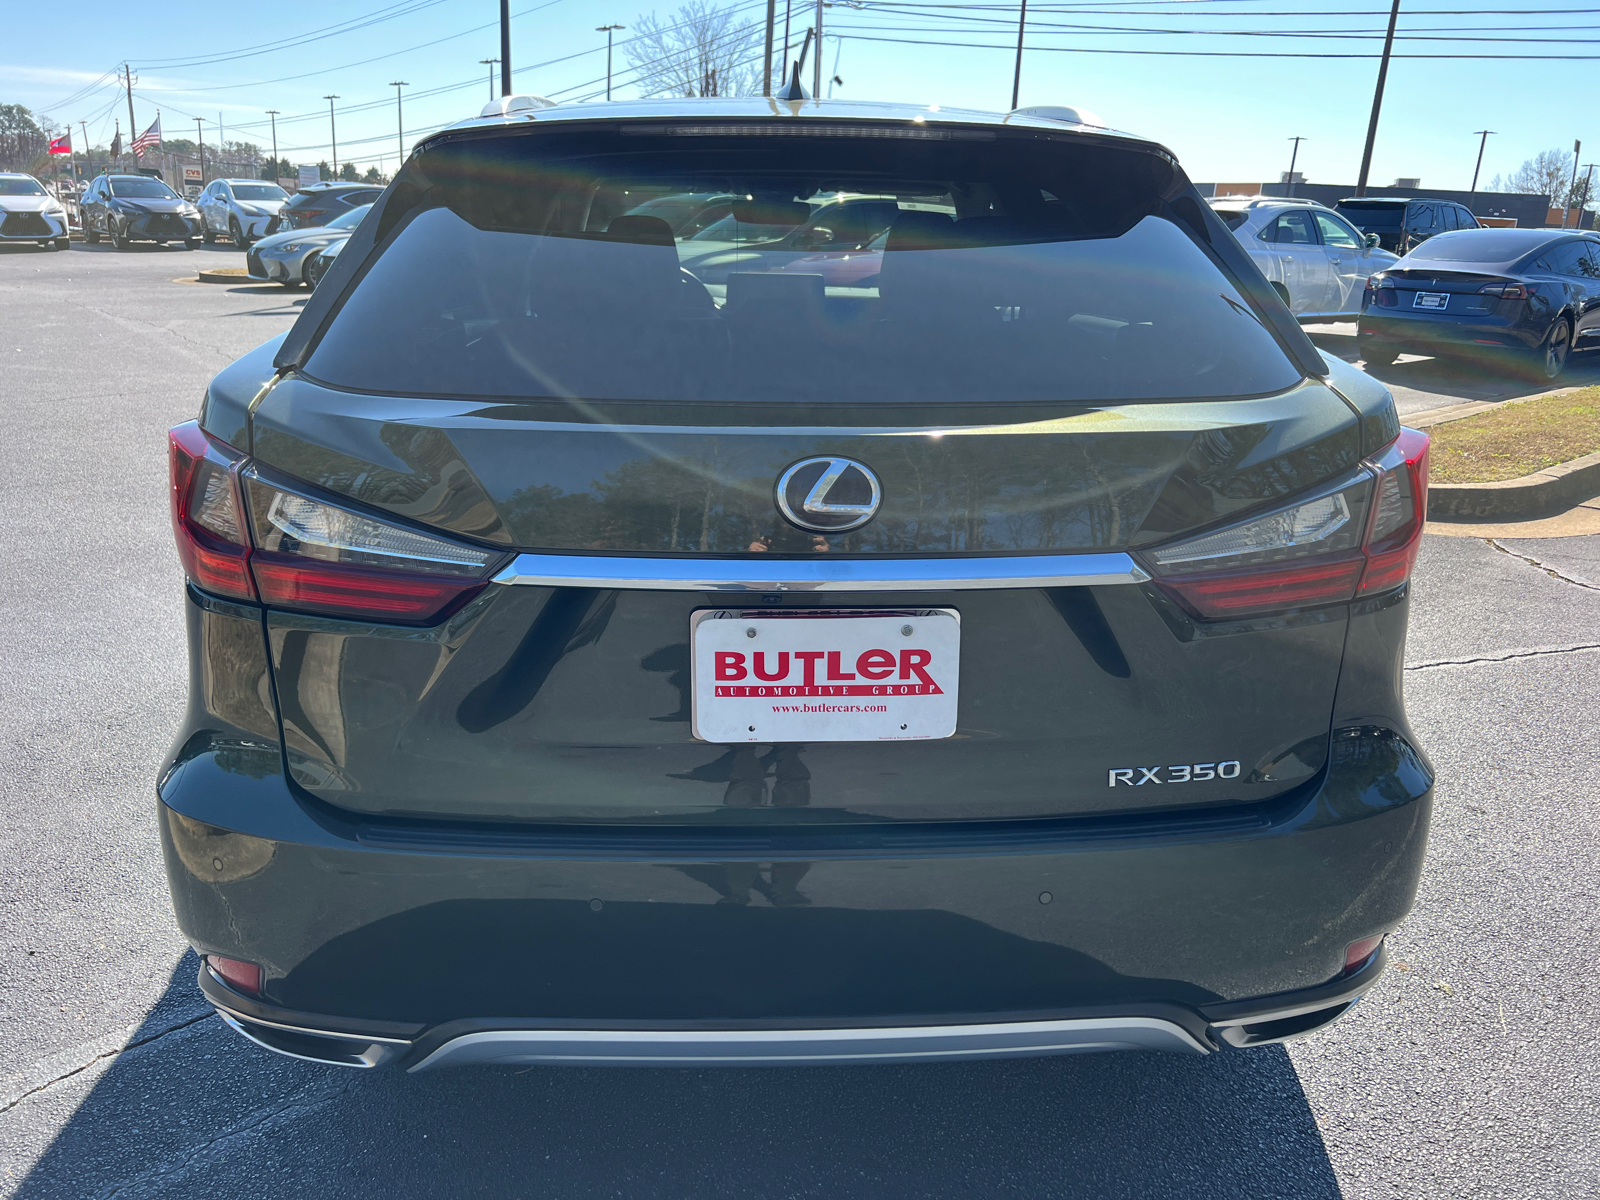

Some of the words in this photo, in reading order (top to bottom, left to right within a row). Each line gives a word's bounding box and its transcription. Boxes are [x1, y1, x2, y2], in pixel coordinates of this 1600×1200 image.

[716, 686, 849, 696] AUTOMOTIVE
[872, 684, 937, 695] GROUP
[772, 703, 887, 713] www.butlercars.com
[1108, 766, 1163, 788] RX
[1167, 760, 1241, 783] 350
